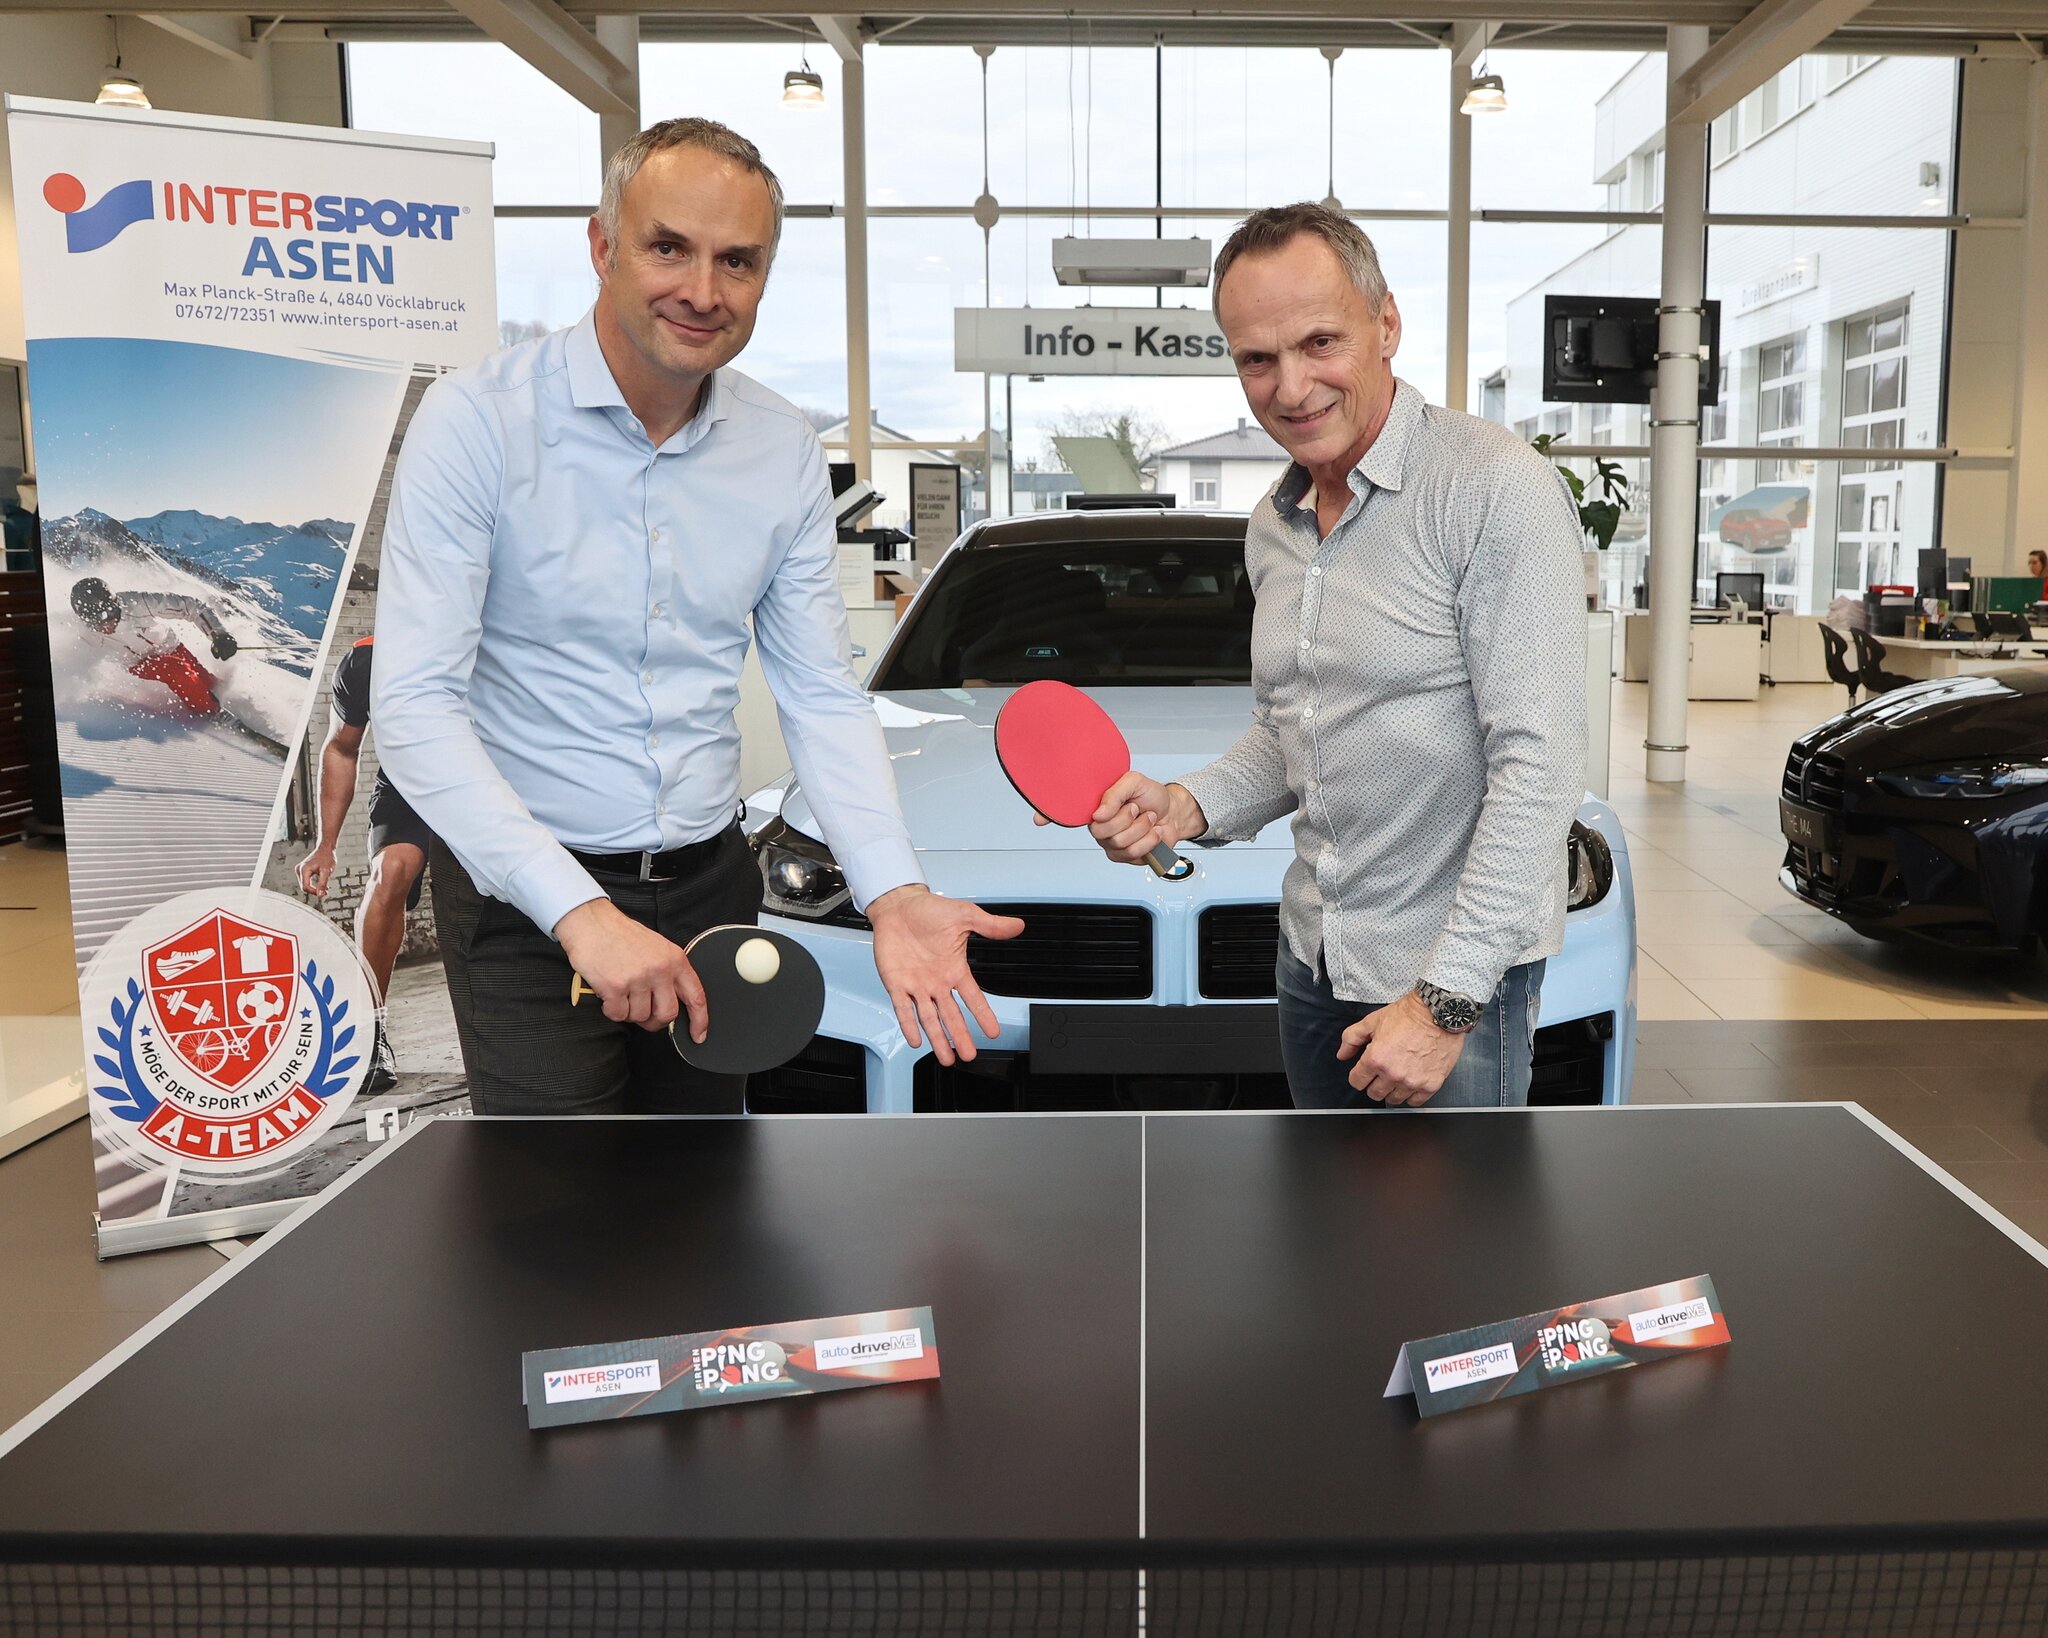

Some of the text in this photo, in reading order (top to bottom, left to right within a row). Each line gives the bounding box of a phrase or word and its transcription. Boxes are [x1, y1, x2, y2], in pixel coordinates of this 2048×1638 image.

[164, 181, 460, 241] INTERSPORT
[242, 237, 395, 285] ASEN
[164, 282, 466, 312] Max Planck-Straße 4, 4840 Vöcklabruck
[175, 304, 459, 332] 07672/72351 www.intersport-asen.at
[1024, 324, 1095, 356] Info
[1107, 341, 1122, 349] -
[140, 1023, 313, 1110] MÖGE DER SPORT MIT DIR SEIN
[153, 1094, 313, 1155] A-TEAM
[1543, 1318, 1594, 1350] PING
[1635, 1318, 1657, 1332] auto
[700, 1341, 766, 1372] PING
[821, 1346, 850, 1359] auto
[1440, 1348, 1509, 1375] INTERSPORT
[1536, 1329, 1552, 1370] FIRMEN
[563, 1365, 652, 1387] INTERSPORT
[692, 1348, 704, 1390] FIRMEN
[1467, 1367, 1488, 1379] ASEN
[595, 1382, 621, 1393] ASEN
